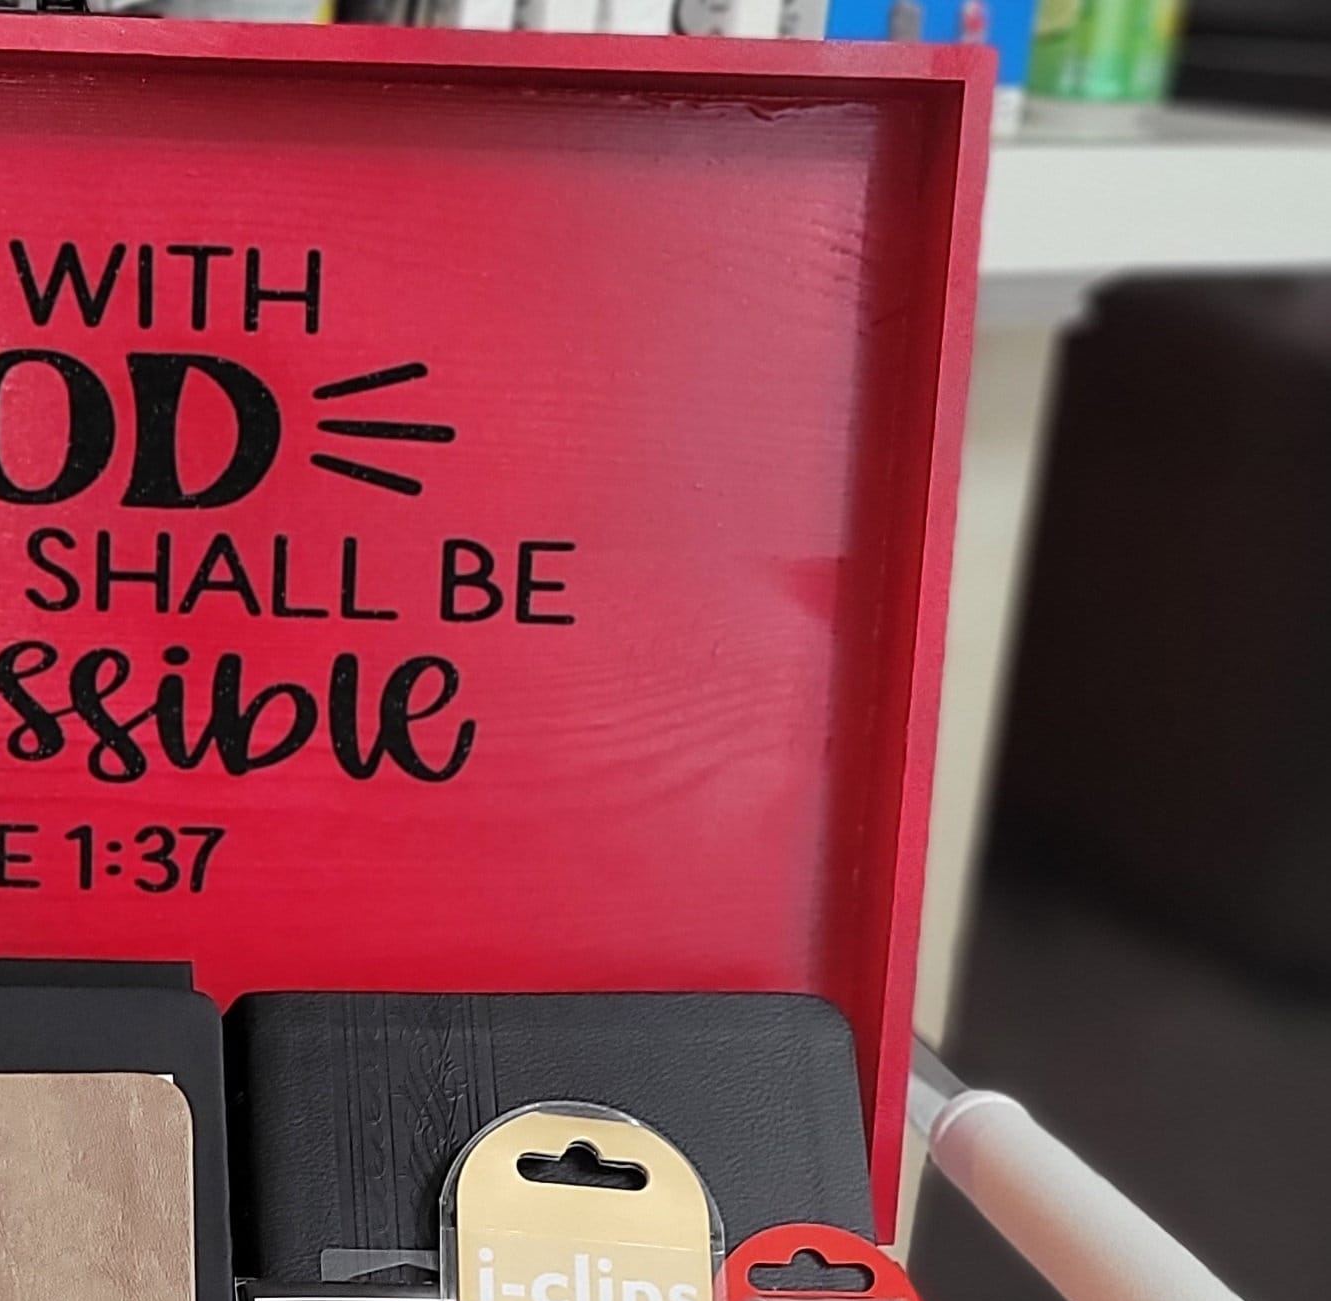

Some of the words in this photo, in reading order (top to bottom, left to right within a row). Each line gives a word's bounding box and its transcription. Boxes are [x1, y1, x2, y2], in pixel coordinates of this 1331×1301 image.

[9, 240, 321, 333] WITH
[24, 528, 398, 619] SHALL
[439, 538, 576, 624] BE
[64, 824, 226, 893] 1:37
